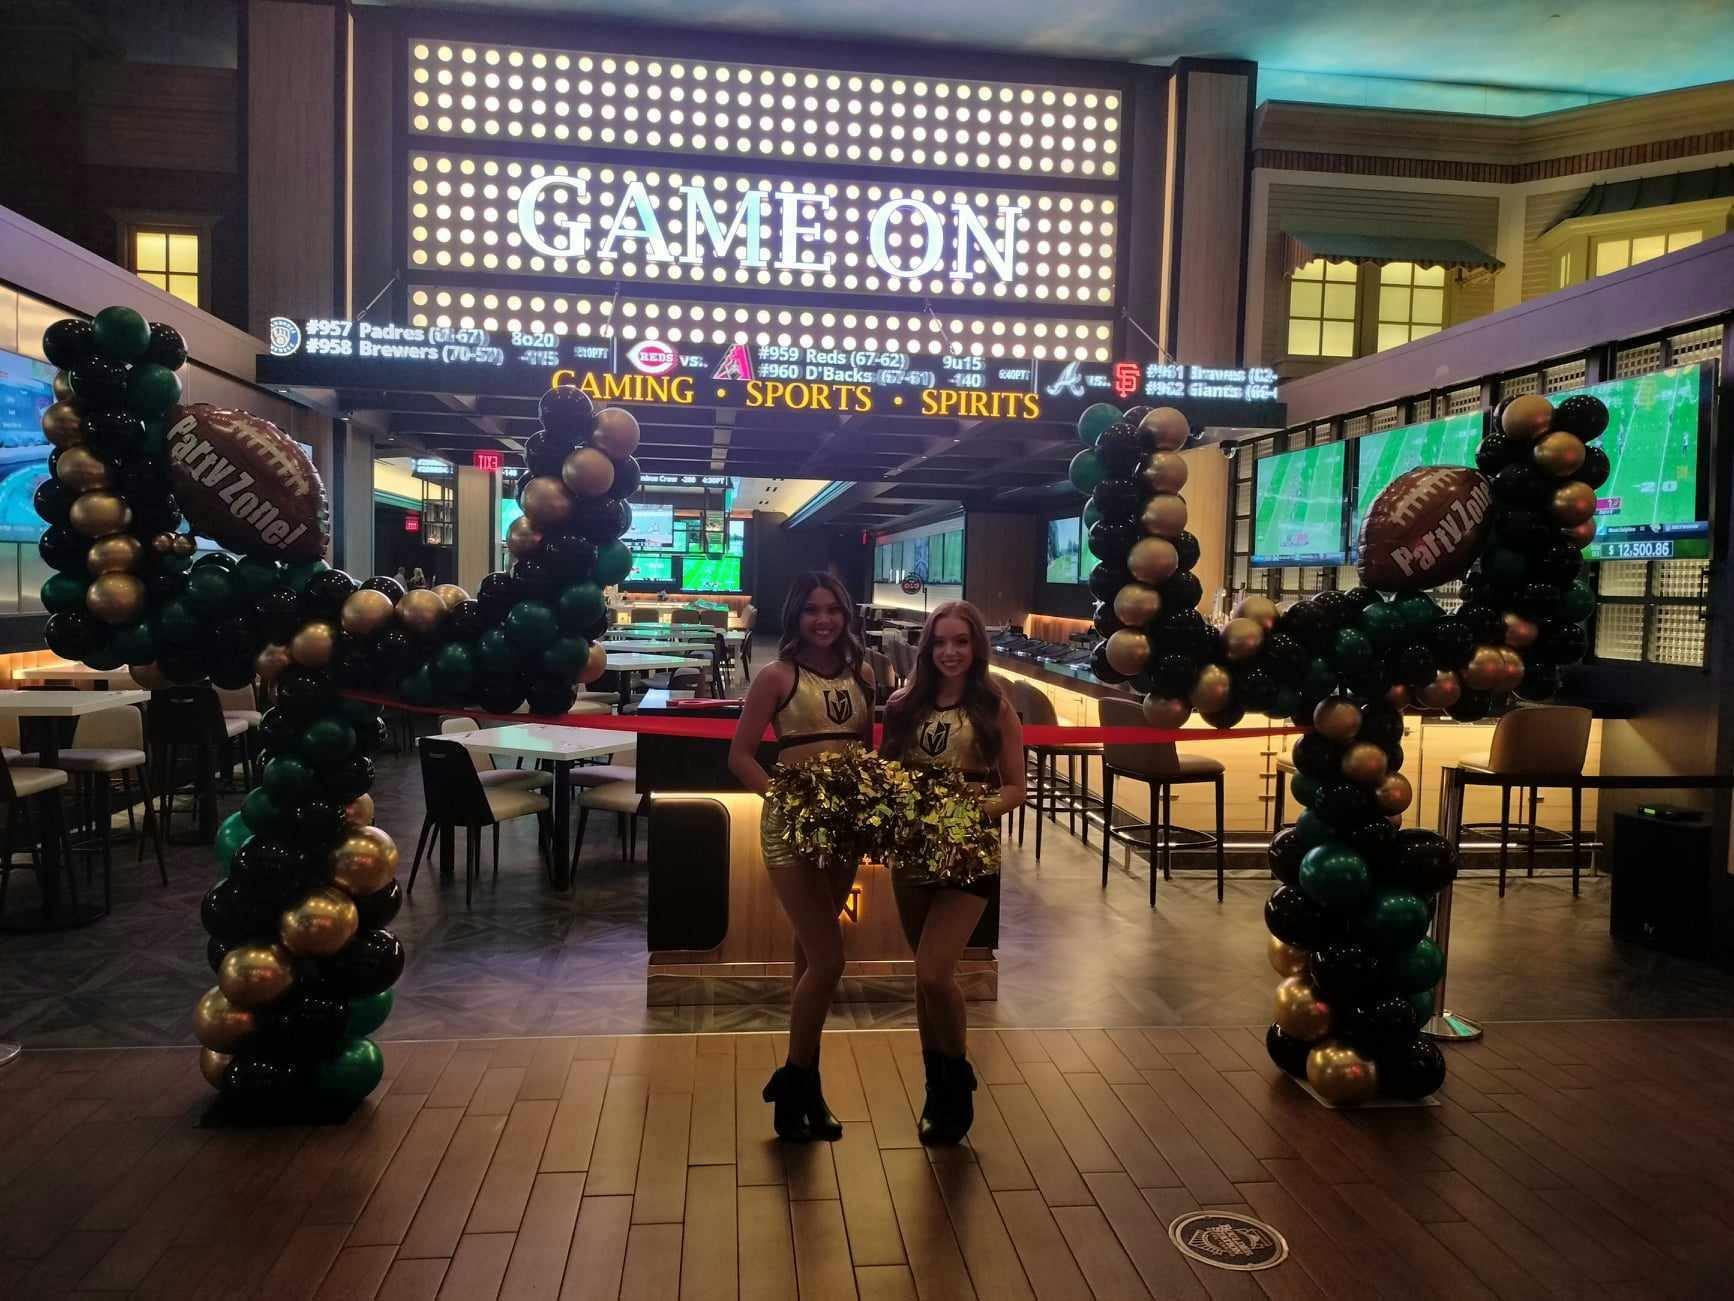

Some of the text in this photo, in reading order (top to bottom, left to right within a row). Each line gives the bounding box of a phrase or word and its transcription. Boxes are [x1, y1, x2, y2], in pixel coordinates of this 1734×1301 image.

[517, 175, 1023, 282] GAME ON
[305, 319, 353, 336] #957
[359, 322, 425, 343] Padres
[305, 338, 353, 355] #958
[359, 340, 439, 360] Brewers
[758, 346, 800, 362] #959
[806, 349, 846, 365] Reds
[850, 351, 908, 369] (67-62)
[758, 363, 800, 379] #960
[806, 366, 873, 383] D'Backs
[551, 370, 1041, 419] GAMING SPORTS SPIRITS
[1188, 381, 1243, 399] Giants
[166, 414, 309, 550] Party Zone!
[1390, 512, 1463, 577] Party
[1618, 542, 1670, 558] 12,500.86
